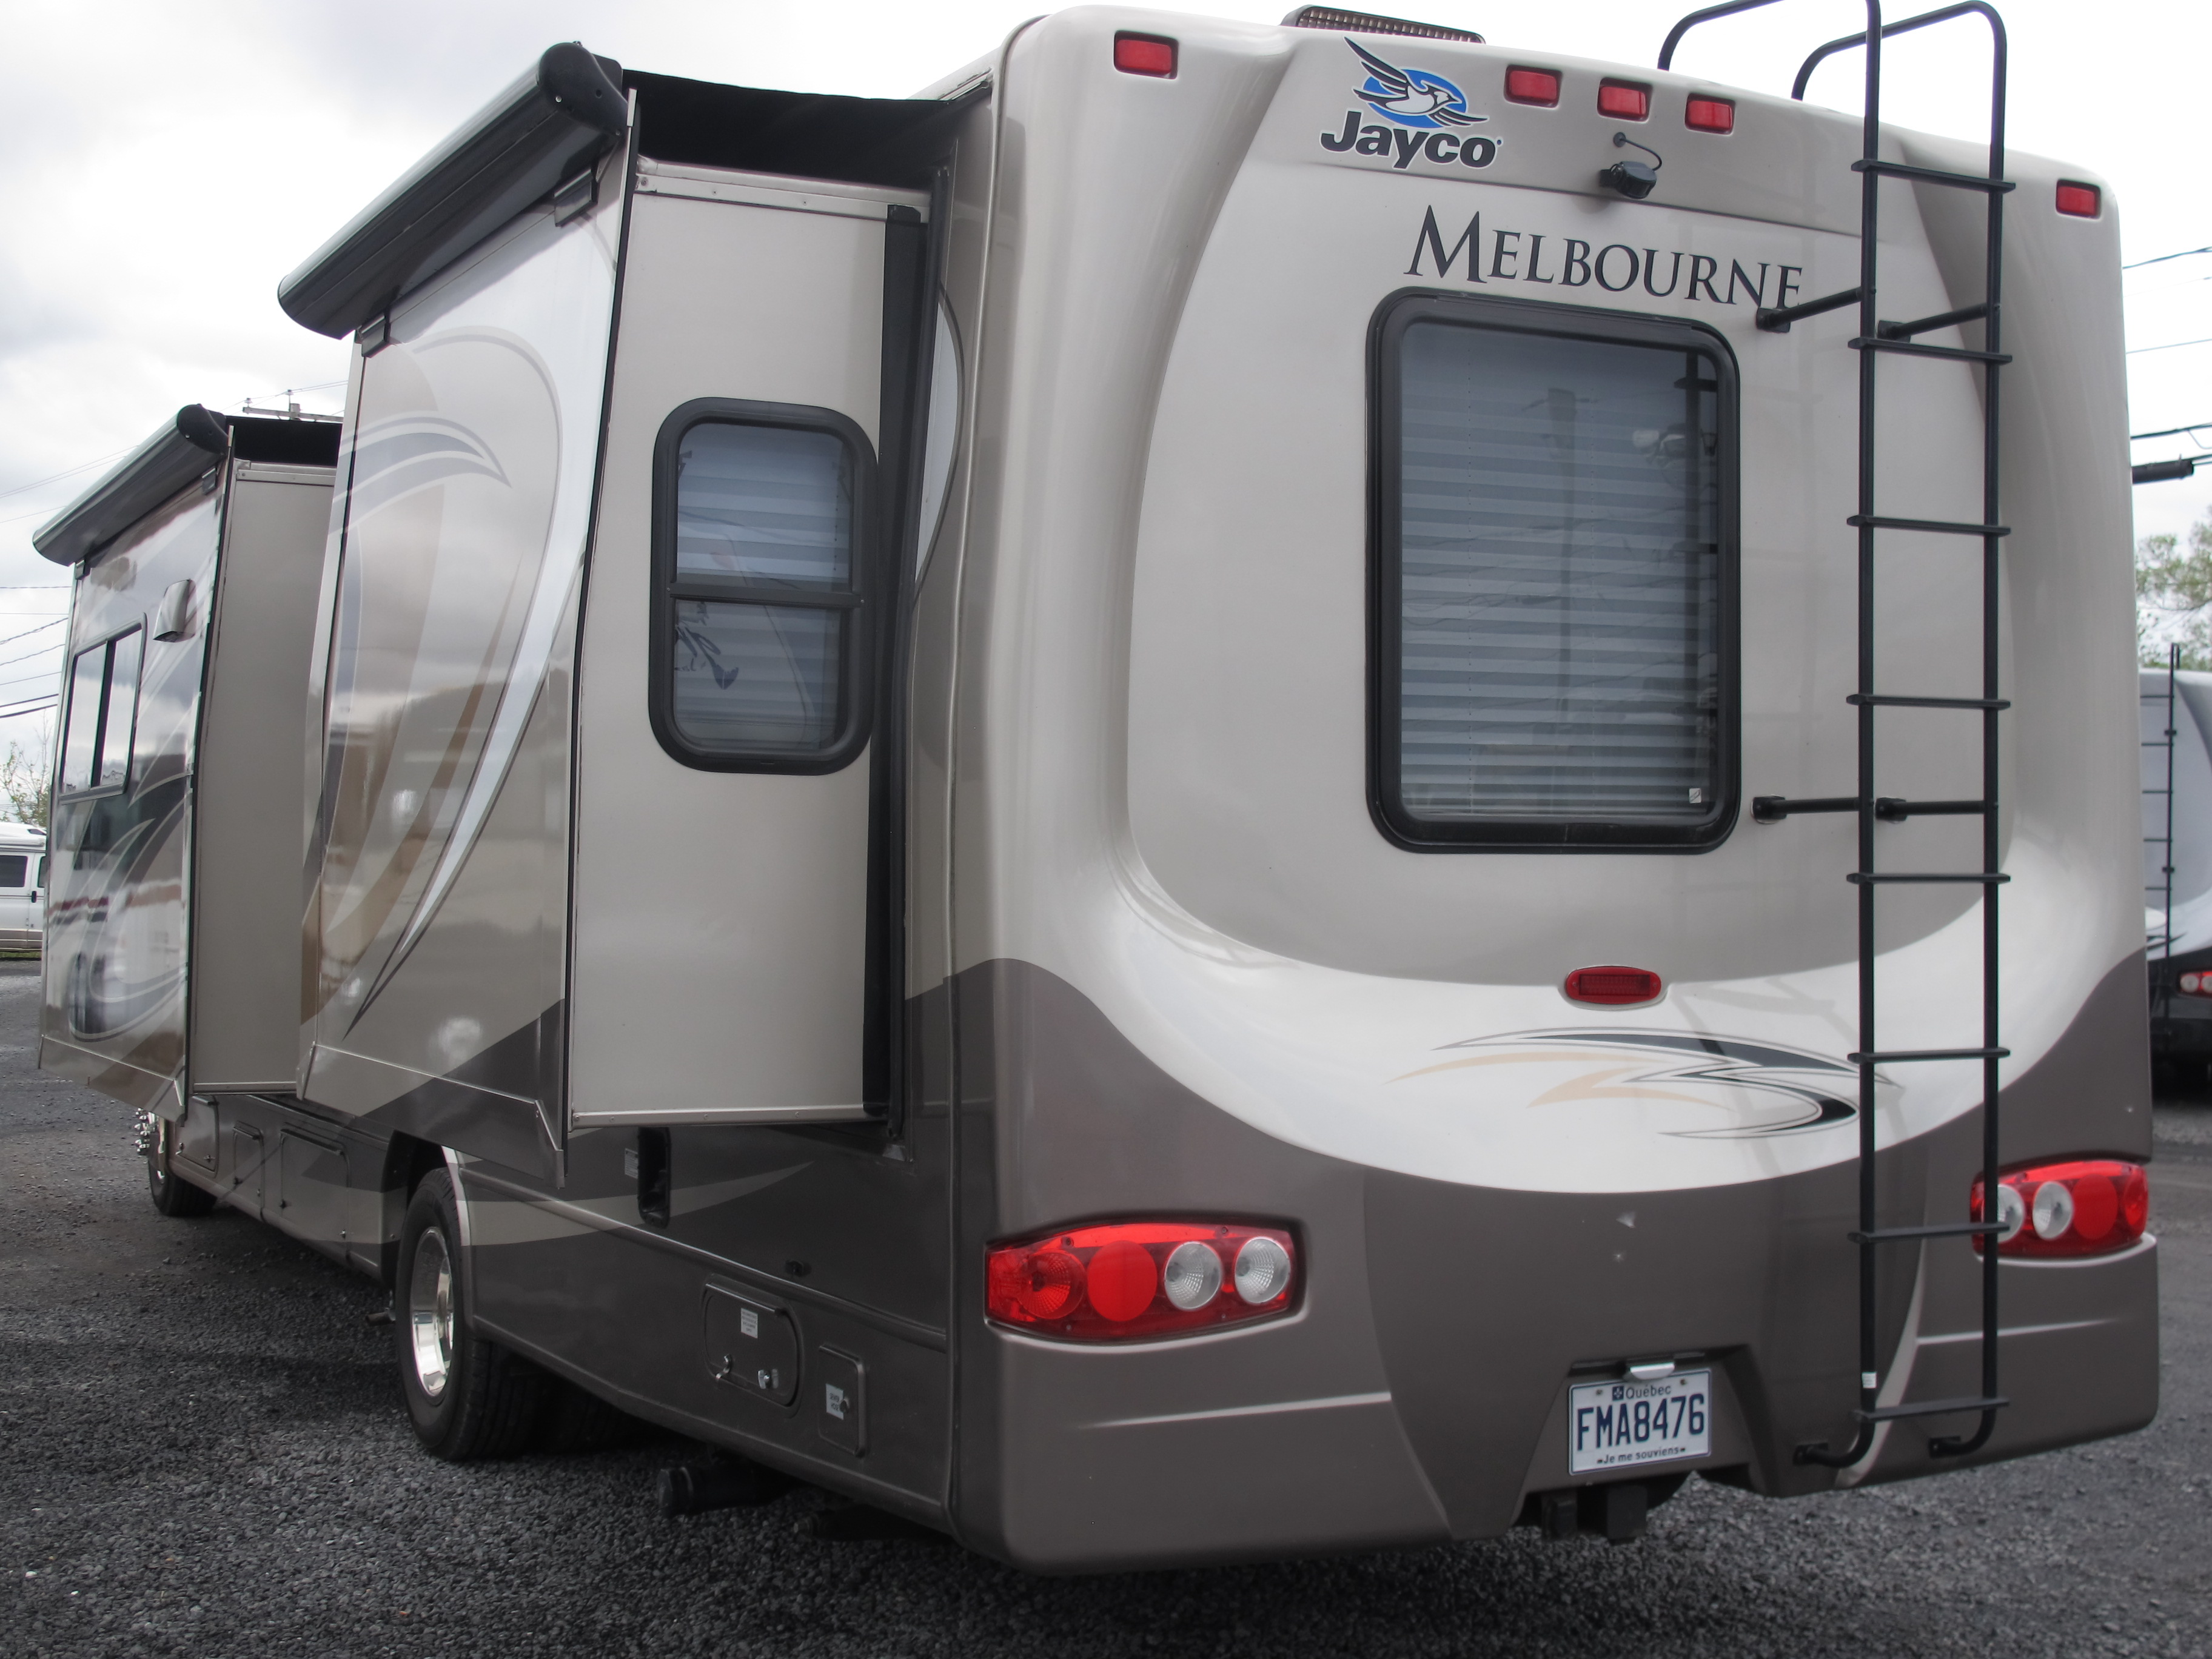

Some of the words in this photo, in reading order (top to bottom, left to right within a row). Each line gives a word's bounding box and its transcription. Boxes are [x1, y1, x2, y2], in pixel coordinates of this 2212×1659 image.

[1320, 110, 1496, 170] Jayco
[1403, 204, 1803, 310] MELBOURNE
[1625, 1384, 1672, 1399] Québec
[1577, 1393, 1704, 1451] FMA8476
[1603, 1454, 1615, 1464] Je
[1618, 1453, 1633, 1463] me
[1635, 1446, 1680, 1460] souviens
